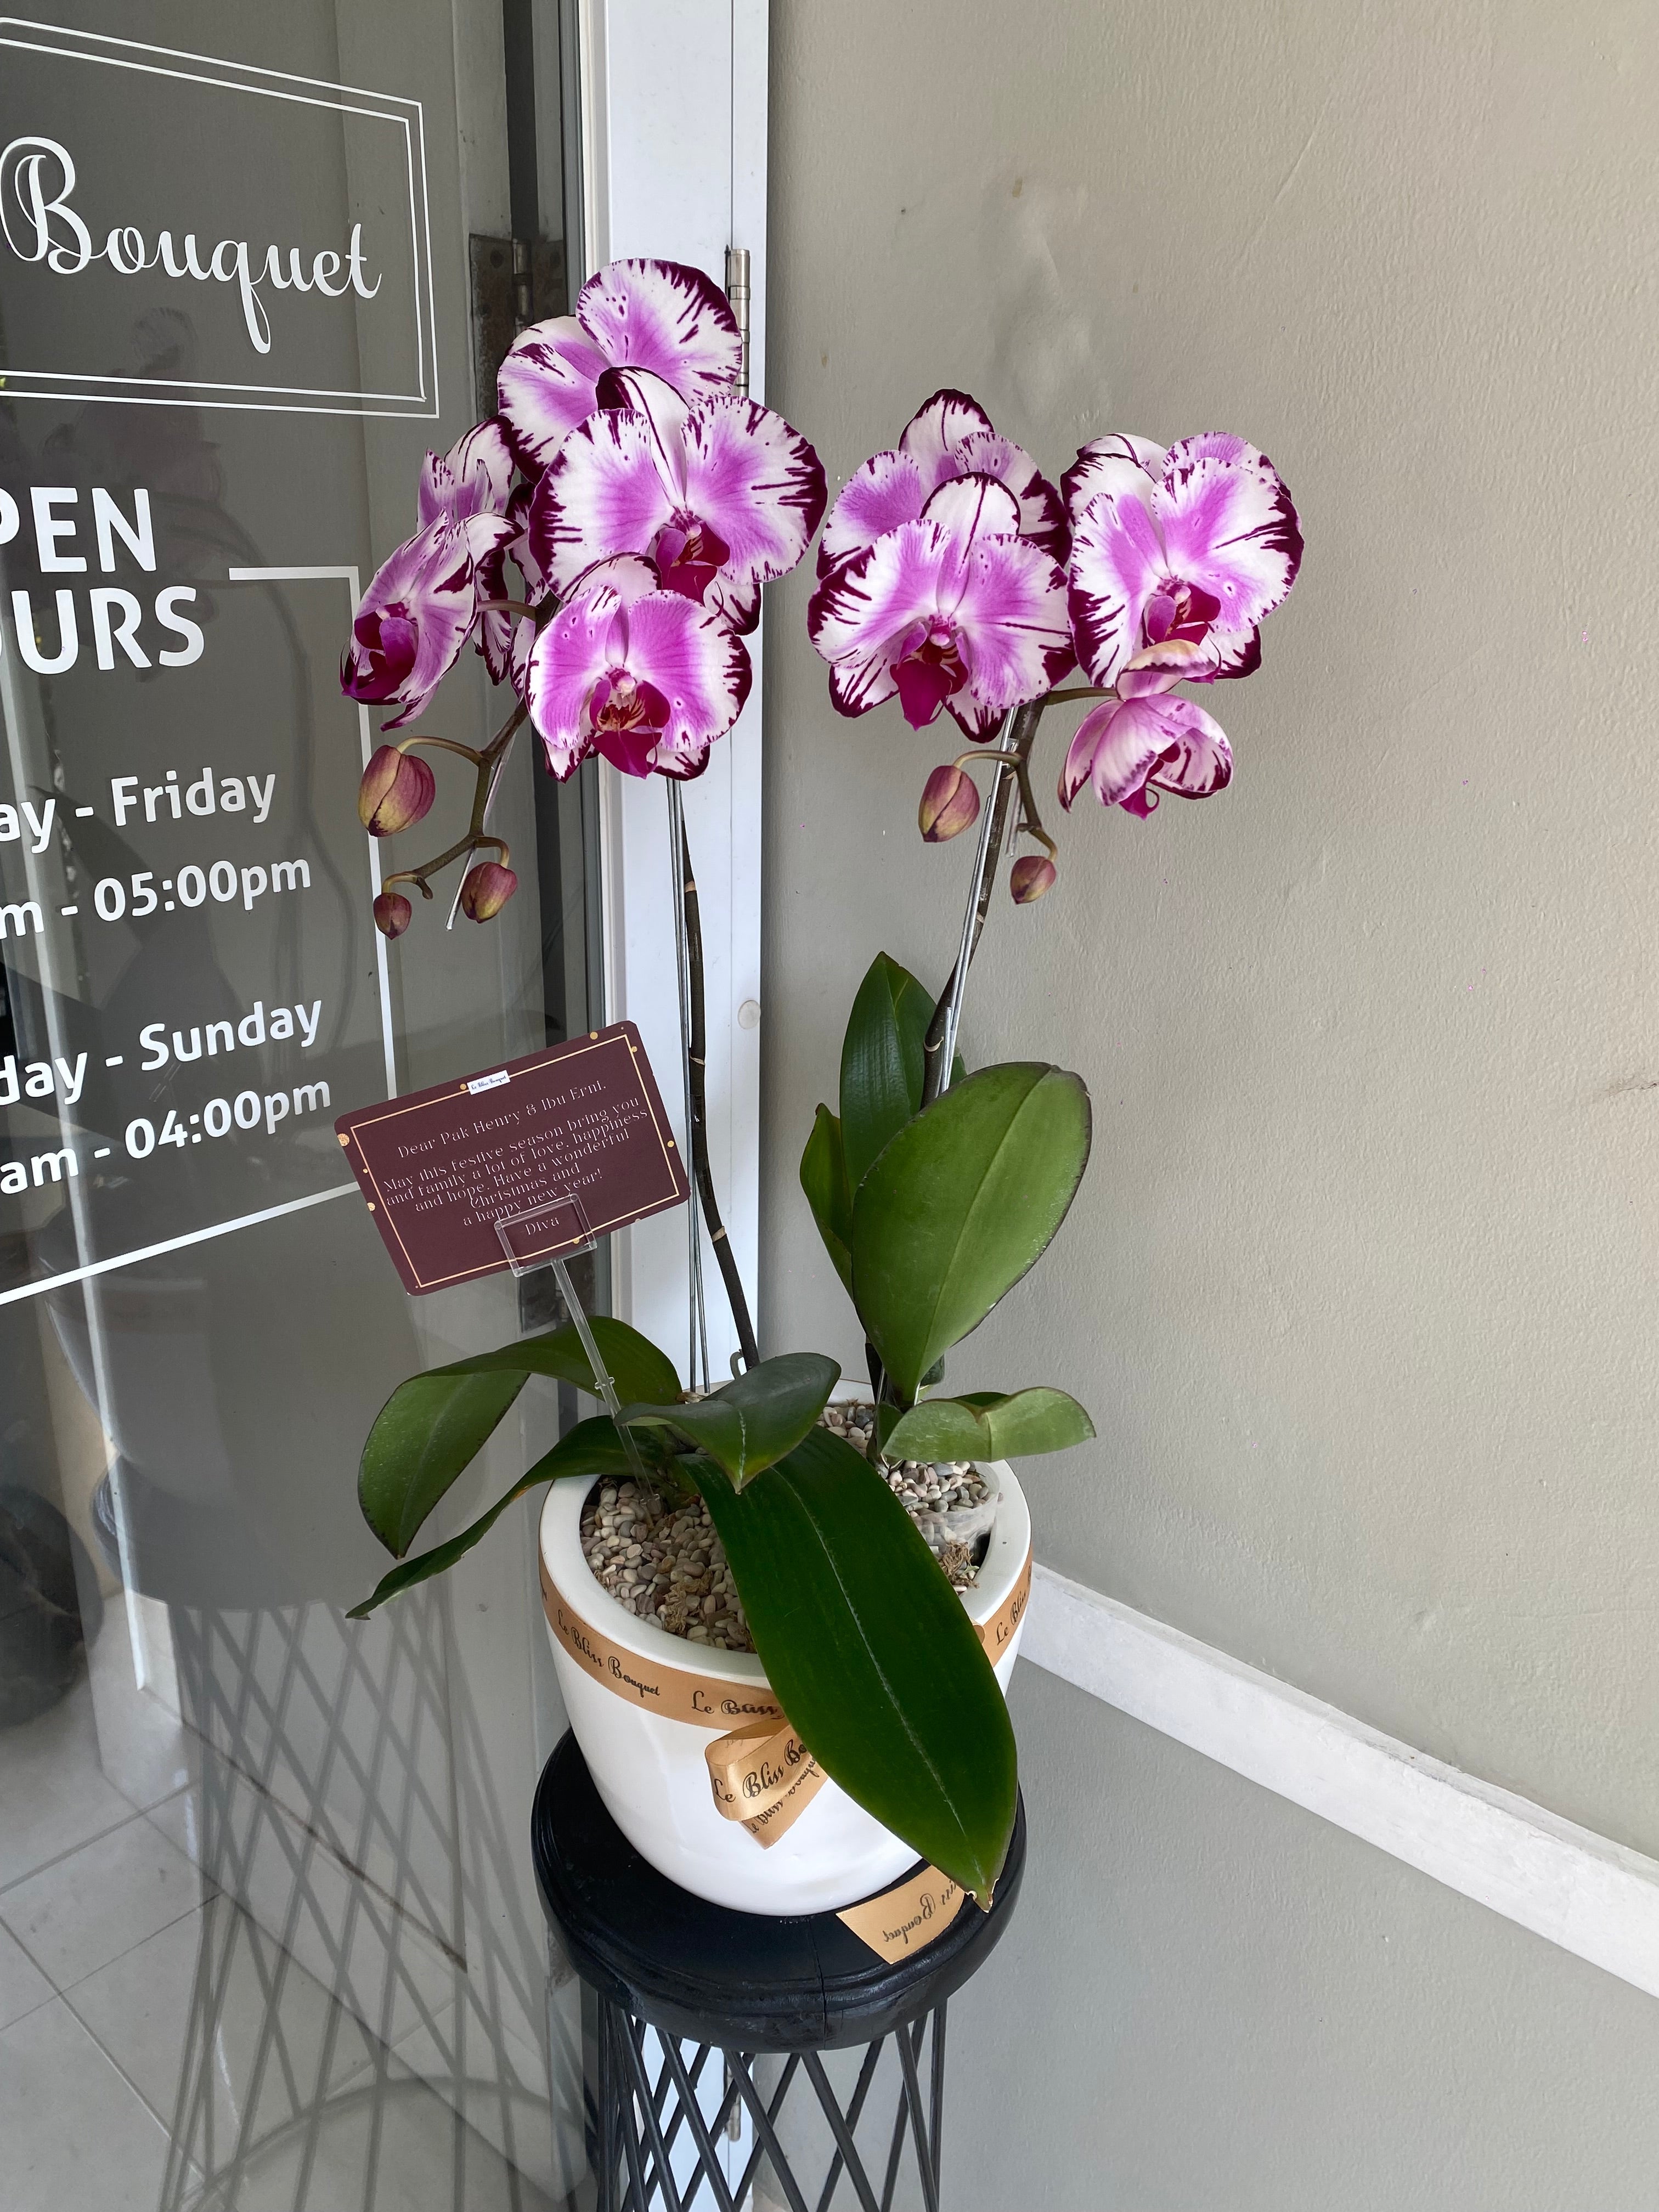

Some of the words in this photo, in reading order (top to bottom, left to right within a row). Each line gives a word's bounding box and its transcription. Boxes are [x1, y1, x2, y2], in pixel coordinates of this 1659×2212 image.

[0, 136, 382, 354] Bouquet
[0, 585, 205, 675] URS
[111, 767, 275, 827] Friday
[93, 859, 311, 922] 05:00pm
[139, 1000, 322, 1071] Sunday
[0, 1146, 78, 1194] am
[124, 1080, 331, 1159] 04:00pm
[383, 1176, 413, 1192] May
[420, 1166, 447, 1181] this
[451, 1147, 504, 1171] festive
[509, 1126, 563, 1152] season
[567, 1110, 609, 1131] bring
[612, 1097, 639, 1118] you
[386, 1188, 414, 1206] and
[418, 1175, 465, 1197] family
[472, 1170, 481, 1180] a
[485, 1161, 505, 1175] lot
[511, 1151, 525, 1166] of
[573, 1109, 647, 1144] happiness
[398, 1139, 435, 1158] Dear
[441, 1127, 469, 1144] Pak
[473, 1111, 520, 1134] Henry
[526, 1103, 537, 1116] &
[541, 1096, 566, 1110] Ibu
[415, 1194, 443, 1212] and
[447, 1183, 490, 1202] hope.
[494, 1167, 531, 1187] Have
[538, 1163, 547, 1172] a
[551, 1128, 630, 1167] wonderful
[463, 1217, 472, 1226] a
[476, 1200, 521, 1222] happy
[528, 1187, 557, 1205] new
[563, 1168, 602, 1196] year!
[471, 1177, 547, 1209] Christmas
[552, 1162, 580, 1182] and
[525, 1217, 560, 1235] Diva
[557, 1609, 569, 1635] Le
[571, 1627, 604, 1667] Bliss
[608, 1656, 660, 1698] Bouquet
[996, 1622, 1009, 1646] Le
[691, 1690, 714, 1714] Le
[714, 1778, 736, 1803] Le
[742, 1762, 785, 1798] Bliss
